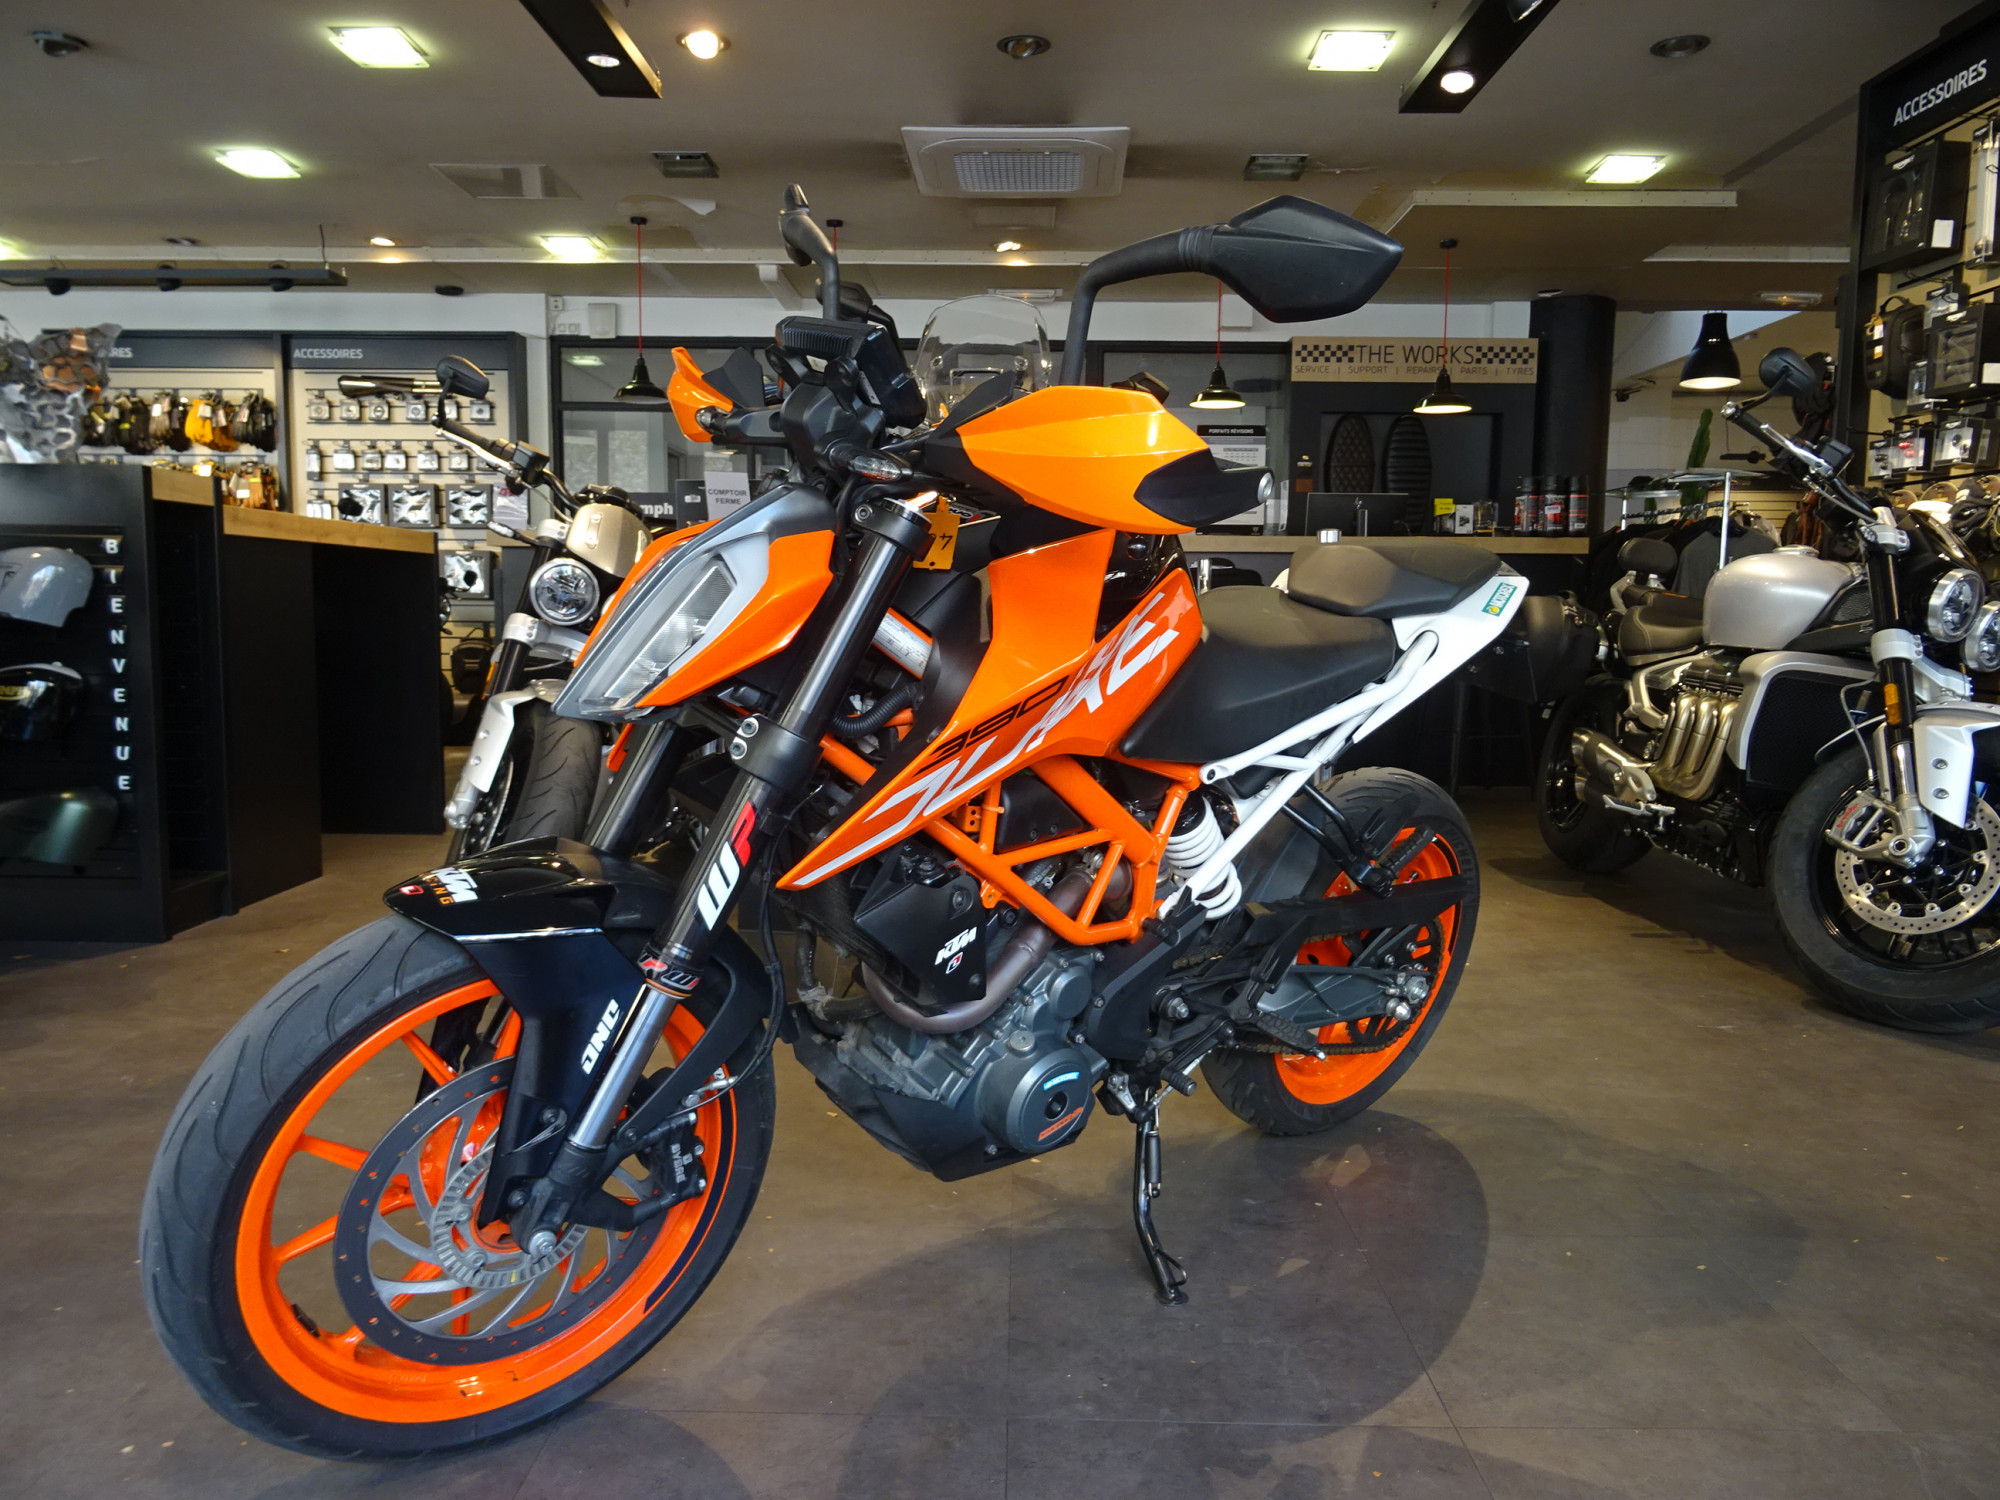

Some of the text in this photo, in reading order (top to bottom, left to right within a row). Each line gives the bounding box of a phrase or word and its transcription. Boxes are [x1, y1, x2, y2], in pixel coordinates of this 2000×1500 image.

[1893, 59, 1987, 127] ACCESSOIRES
[293, 348, 363, 359] ACCESSOIRES
[1356, 345, 1474, 364] THE WORKS
[1295, 365, 1330, 374] SERVICE
[1348, 365, 1388, 374] SUPPORT
[1460, 366, 1488, 375] PARTS
[1506, 367, 1534, 375] TYRES
[708, 488, 747, 496] COMPTOIR
[640, 503, 674, 518] mph
[104, 538, 131, 791] BIENVENUE
[910, 674, 1070, 779] 390
[430, 866, 478, 903] KTM
[934, 926, 977, 965] KTM
